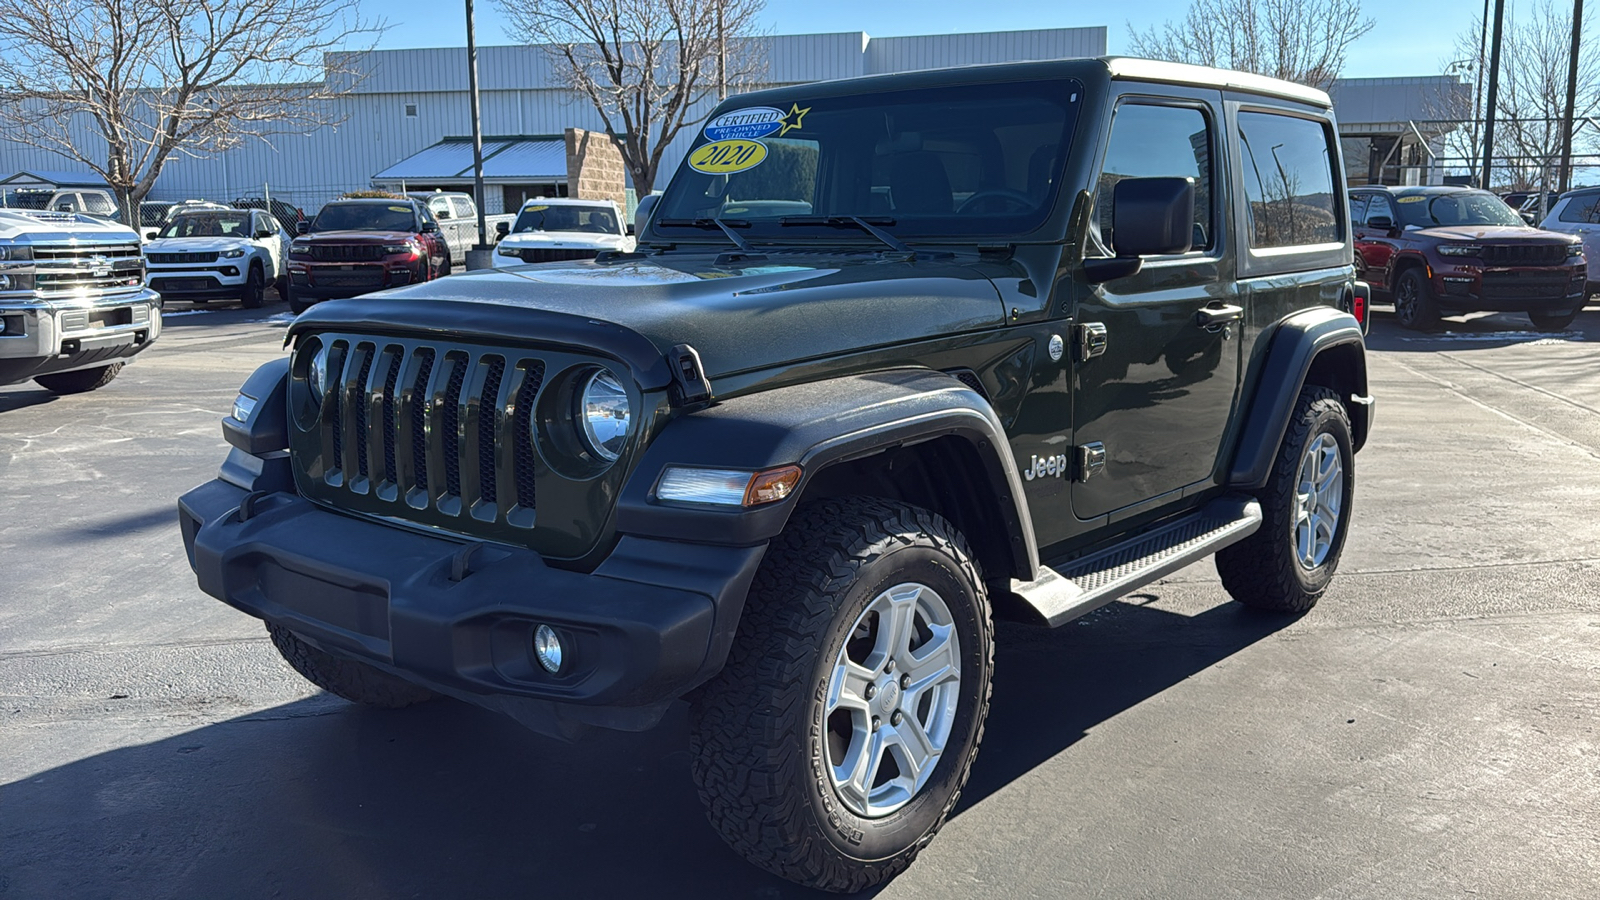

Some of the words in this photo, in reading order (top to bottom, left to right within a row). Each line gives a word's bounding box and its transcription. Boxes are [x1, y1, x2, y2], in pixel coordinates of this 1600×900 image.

[716, 112, 780, 127] CERTIFIED
[714, 124, 771, 135] PRE-OWNED
[720, 131, 760, 139] VEHICLE
[696, 144, 758, 166] 2020
[1024, 454, 1067, 481] Jeep
